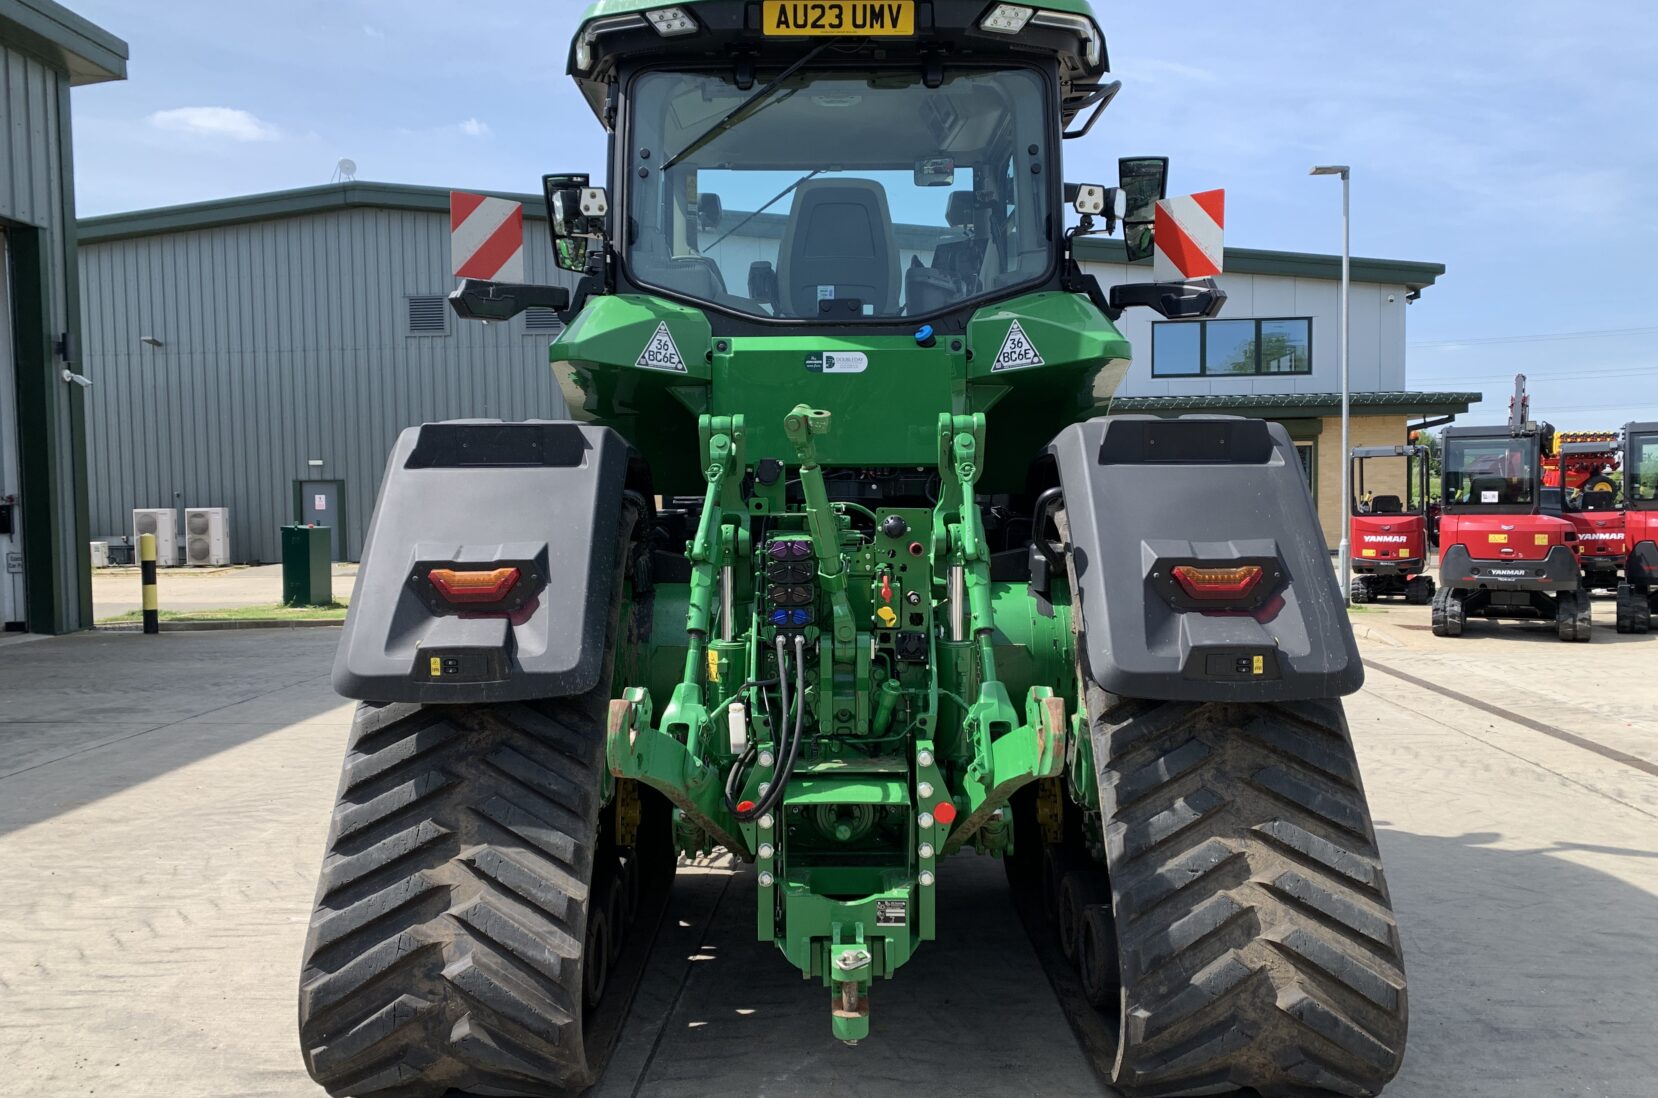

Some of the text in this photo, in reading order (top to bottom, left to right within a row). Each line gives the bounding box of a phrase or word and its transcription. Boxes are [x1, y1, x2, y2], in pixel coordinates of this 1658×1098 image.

[775, 3, 903, 29] AU23 UMV
[655, 338, 670, 351] 36
[1009, 337, 1024, 350] 36
[647, 350, 676, 364] BC6E
[1002, 348, 1032, 363] BC6E
[1363, 535, 1408, 543] YANMAR
